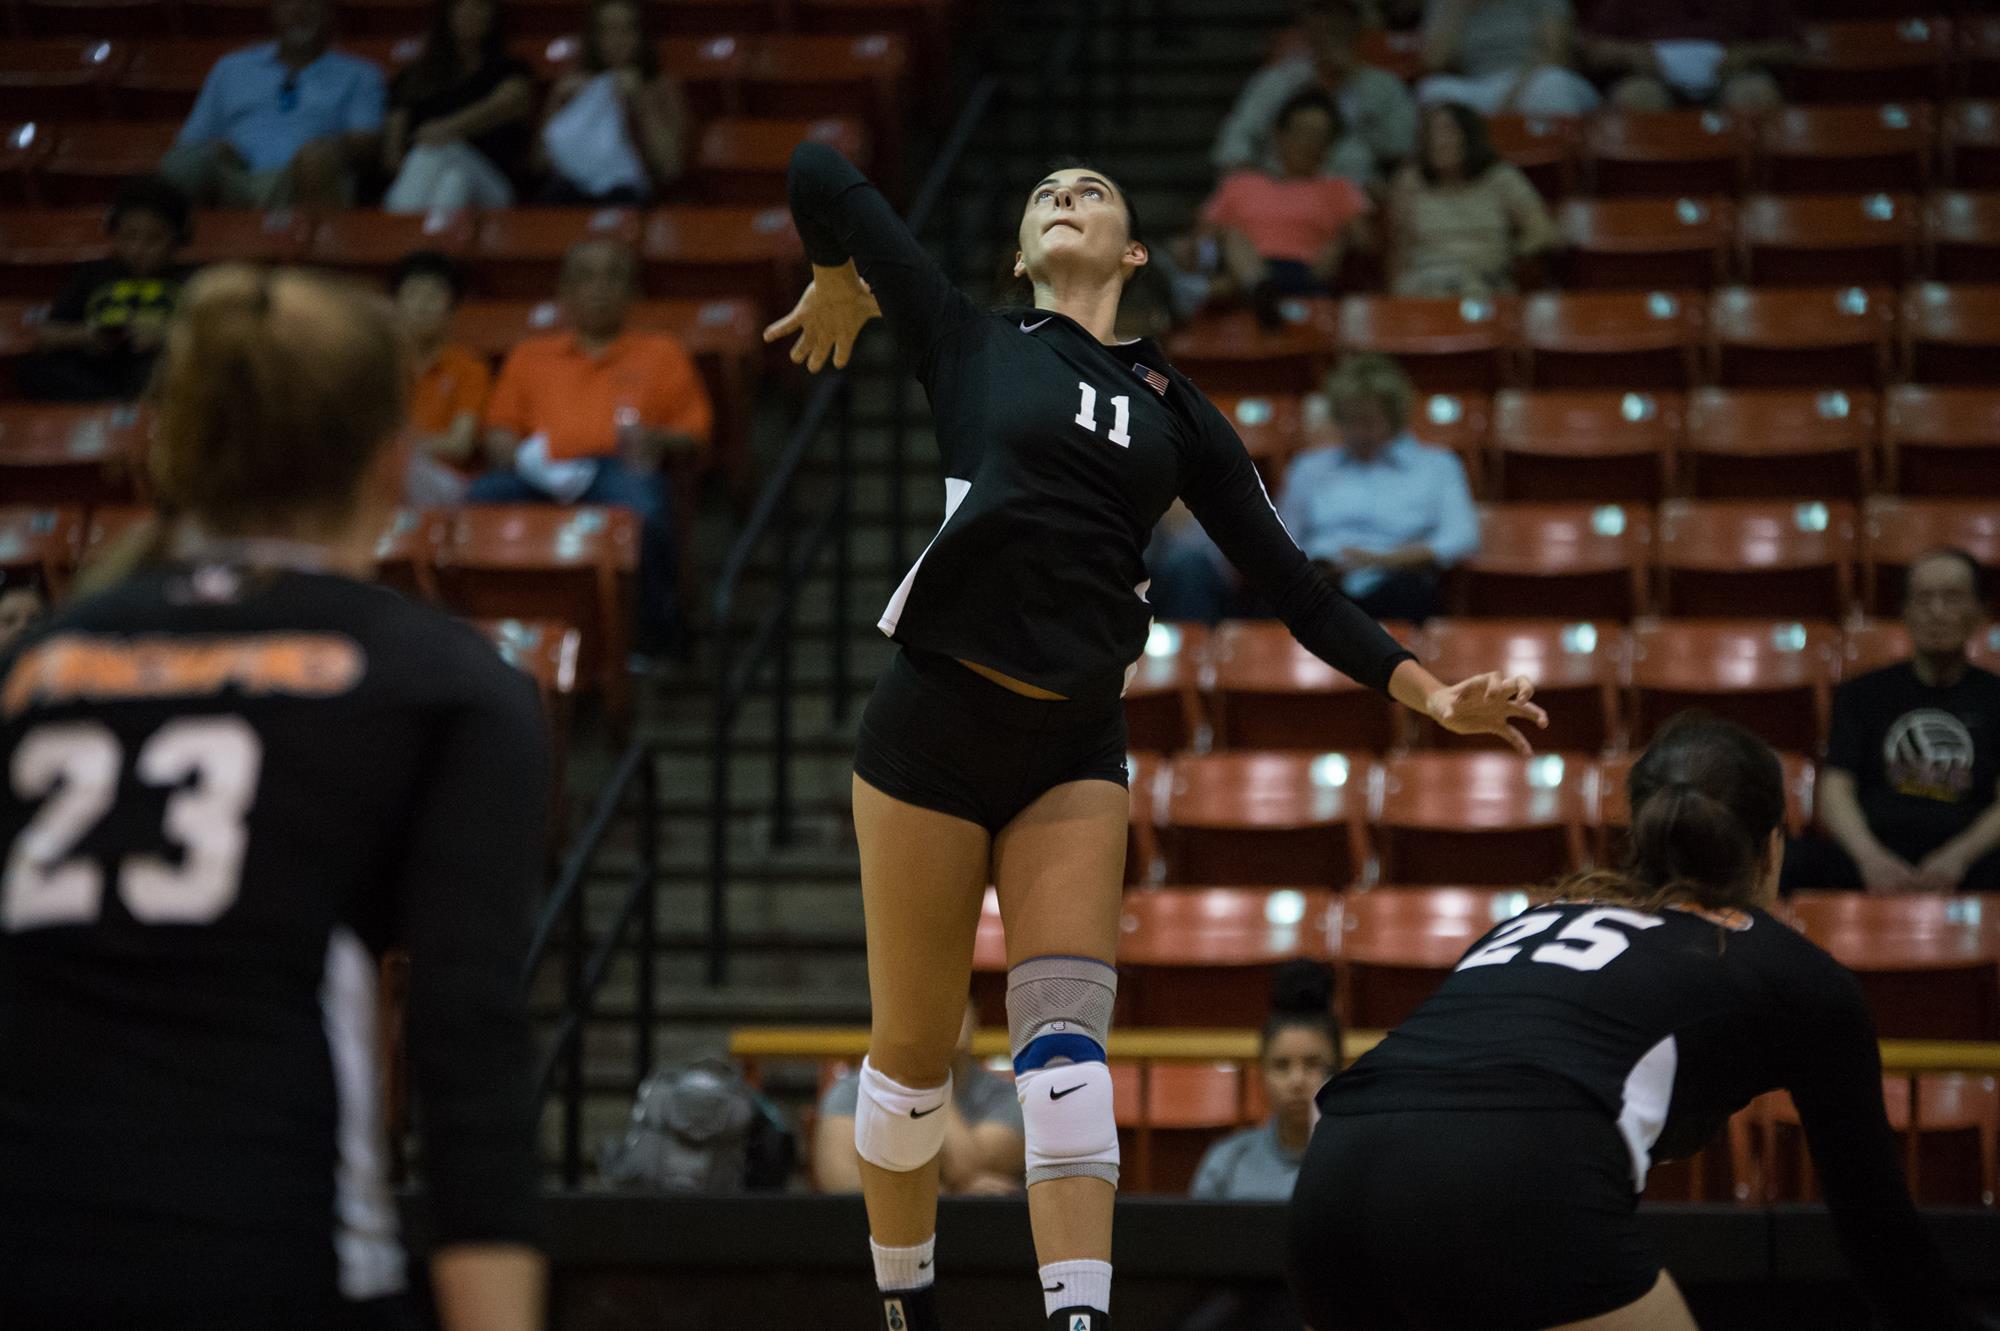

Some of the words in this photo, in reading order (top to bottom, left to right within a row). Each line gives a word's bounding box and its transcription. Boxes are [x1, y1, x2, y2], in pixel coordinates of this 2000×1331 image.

[1074, 381, 1131, 449] 11
[1, 717, 262, 930] 23
[1455, 905, 1666, 972] 25
